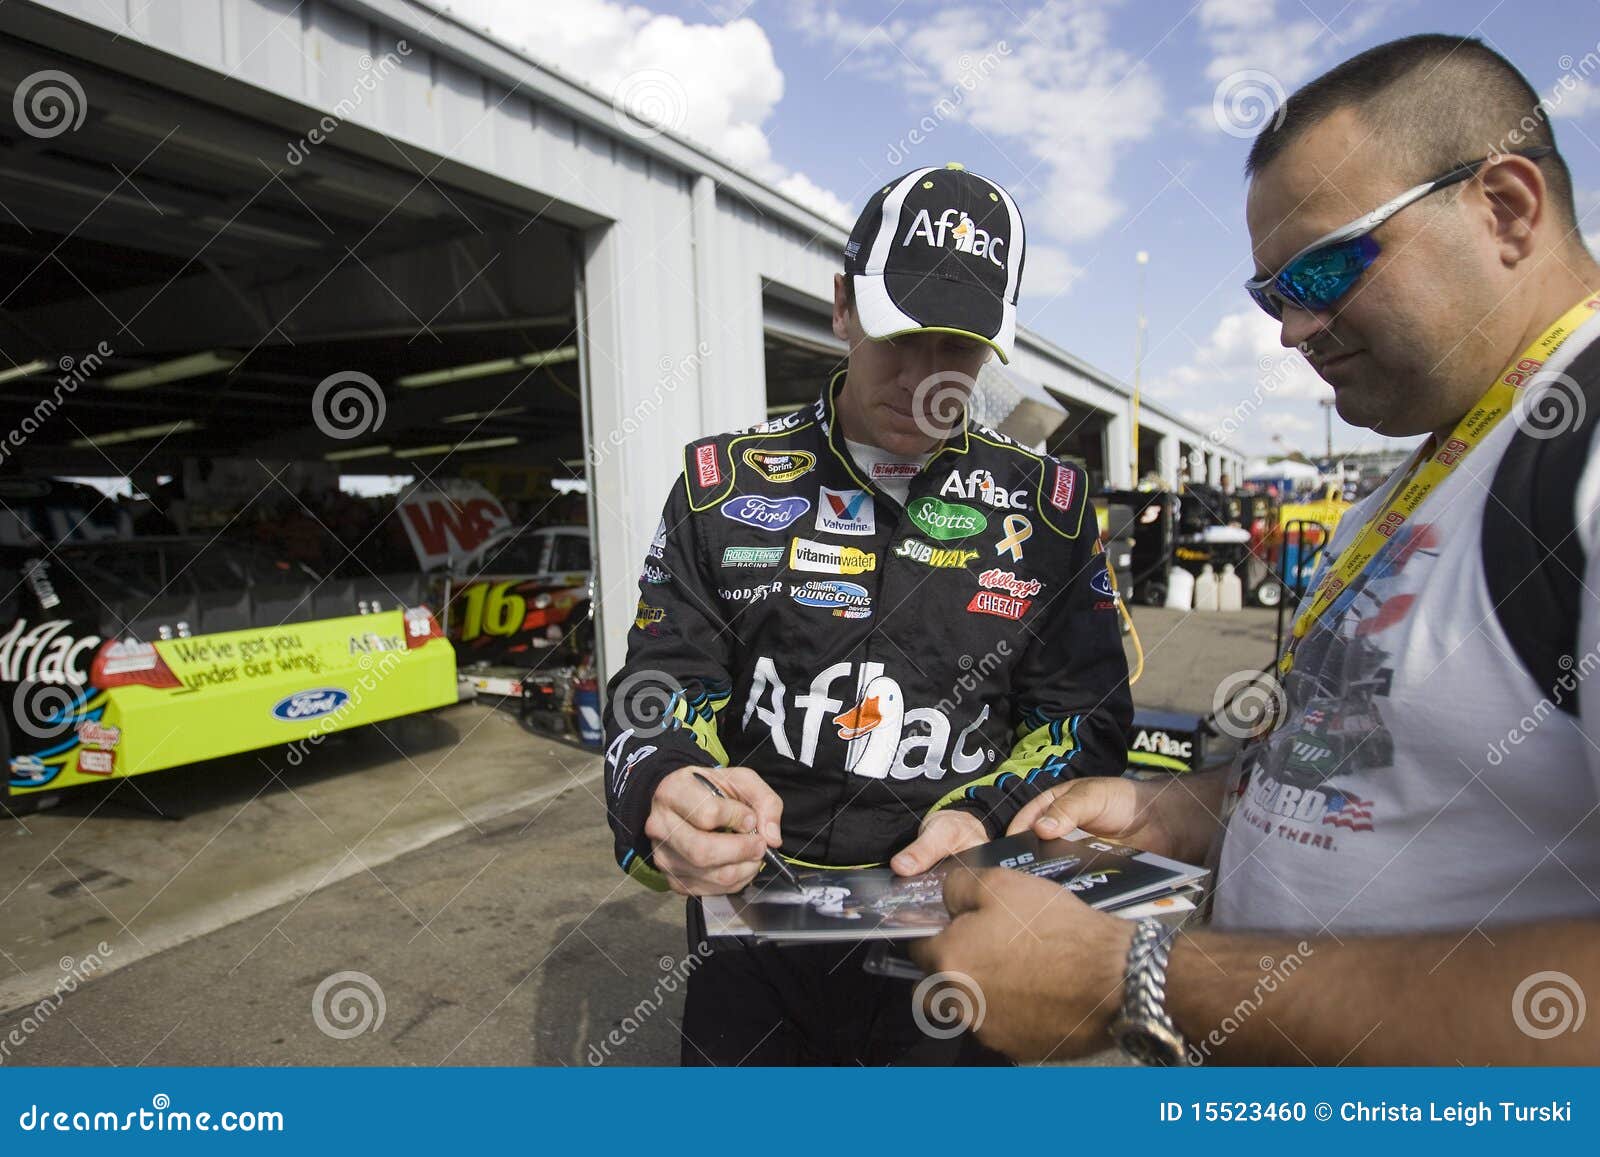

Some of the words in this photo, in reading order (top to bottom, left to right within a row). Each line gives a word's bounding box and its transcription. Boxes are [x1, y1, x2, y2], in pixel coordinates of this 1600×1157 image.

[902, 208, 1005, 267] Aflac
[1503, 358, 1542, 388] 29
[1465, 408, 1486, 429] KEVIN
[768, 462, 792, 472] Sprint
[1436, 438, 1469, 467] 29
[875, 465, 918, 475] SIMPSON
[940, 469, 1028, 509] Aflac
[1054, 468, 1074, 509] SIMPSON
[1403, 484, 1419, 501] KEVIN
[740, 498, 793, 523] Ford
[823, 518, 868, 531] Valvoline
[1376, 510, 1406, 538] 29
[796, 548, 874, 568] vitaminwater
[896, 539, 980, 568] SUBWAY
[979, 568, 1042, 597] Kellogg's
[461, 580, 526, 642] 16
[0, 618, 101, 686] Aflac
[174, 639, 233, 663] We've
[238, 637, 268, 663] got
[270, 635, 302, 657] you
[183, 663, 239, 690] under
[243, 660, 272, 678] our
[742, 656, 989, 780] Aflac
[1132, 729, 1193, 758] Aflac
